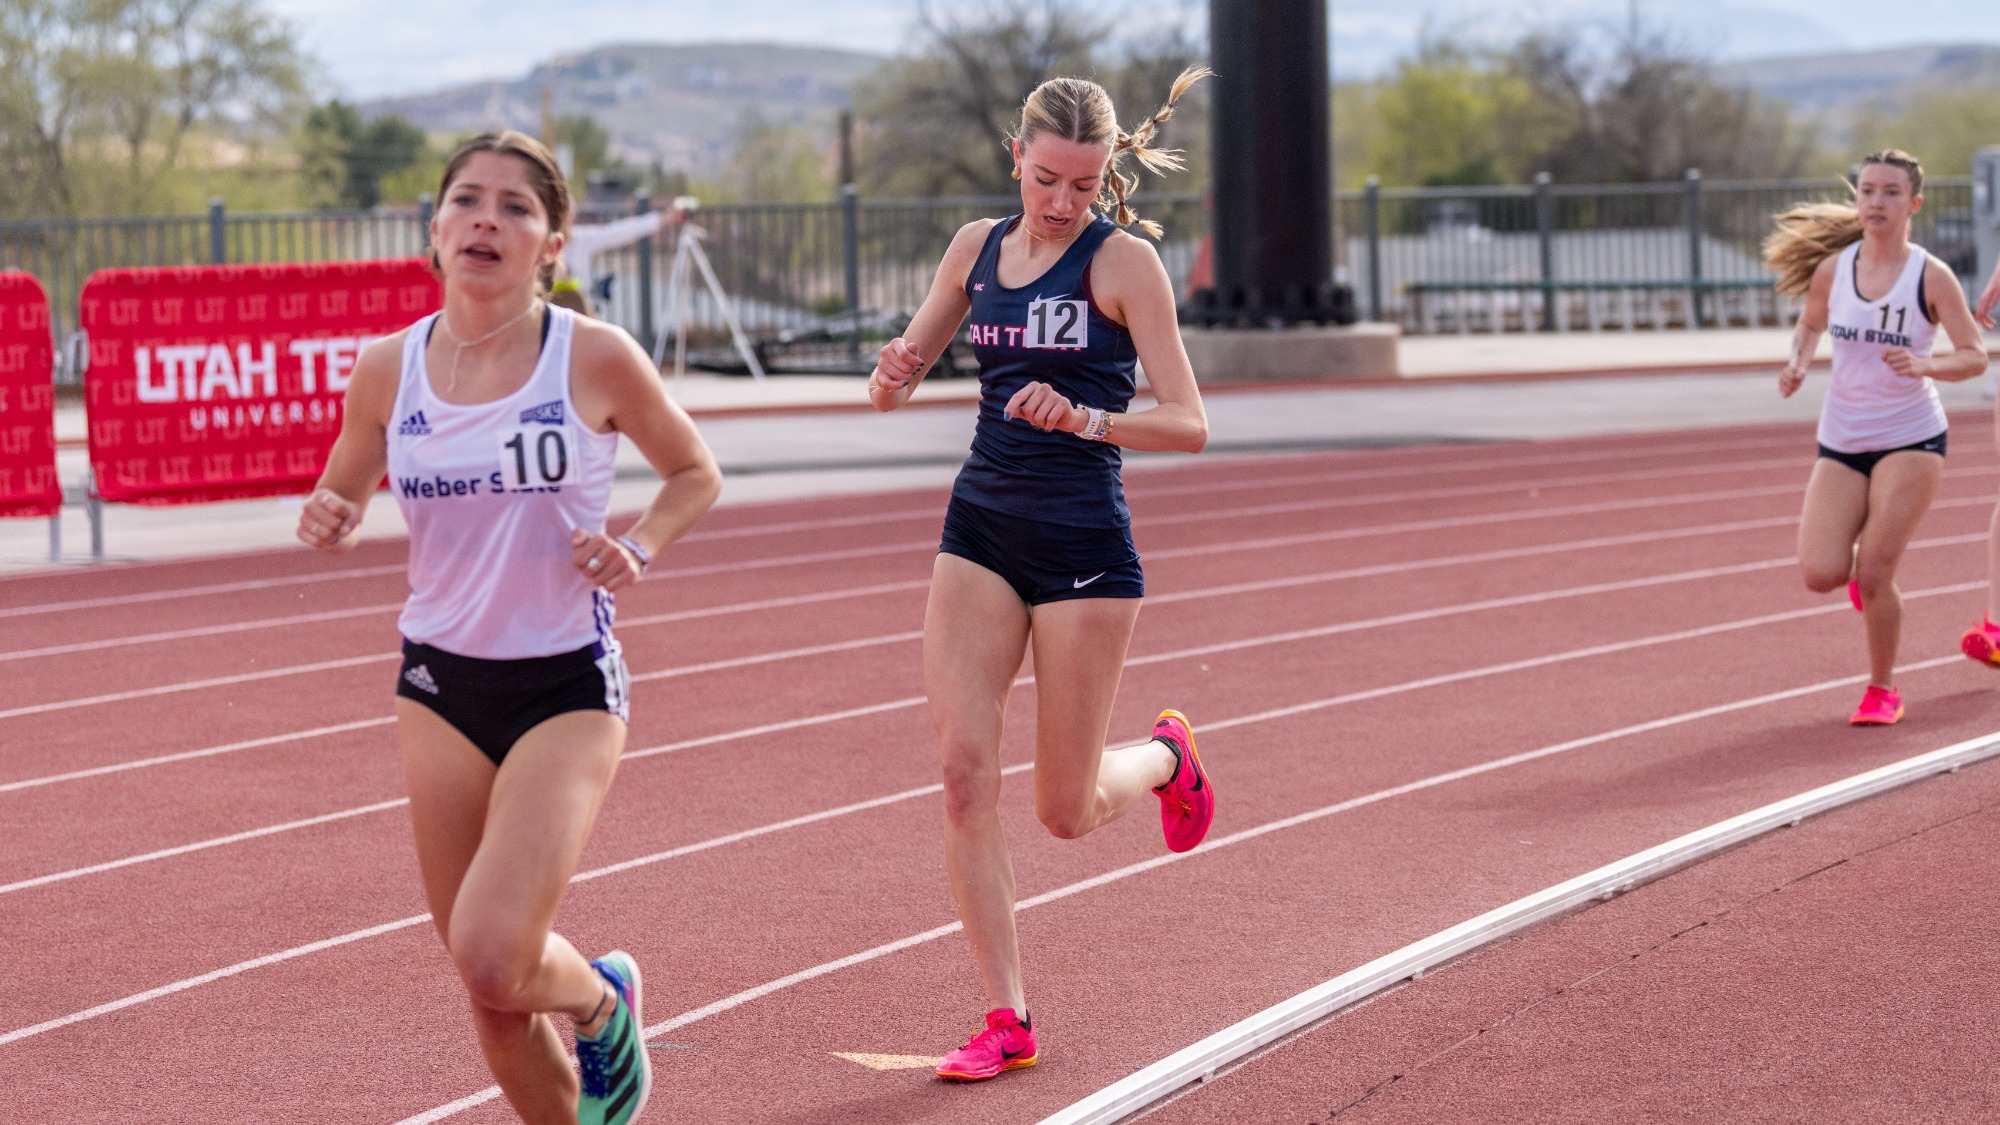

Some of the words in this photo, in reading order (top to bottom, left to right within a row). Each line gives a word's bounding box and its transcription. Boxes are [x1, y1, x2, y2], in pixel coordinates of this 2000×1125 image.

[1032, 301, 1078, 345] 12
[1880, 303, 1906, 333] 11
[1864, 328, 1912, 348] STATE
[134, 340, 278, 404] UTAH
[289, 335, 387, 393] TE
[189, 397, 345, 431] UNIVERSI
[505, 429, 567, 485] 10
[398, 474, 481, 498] Weber
